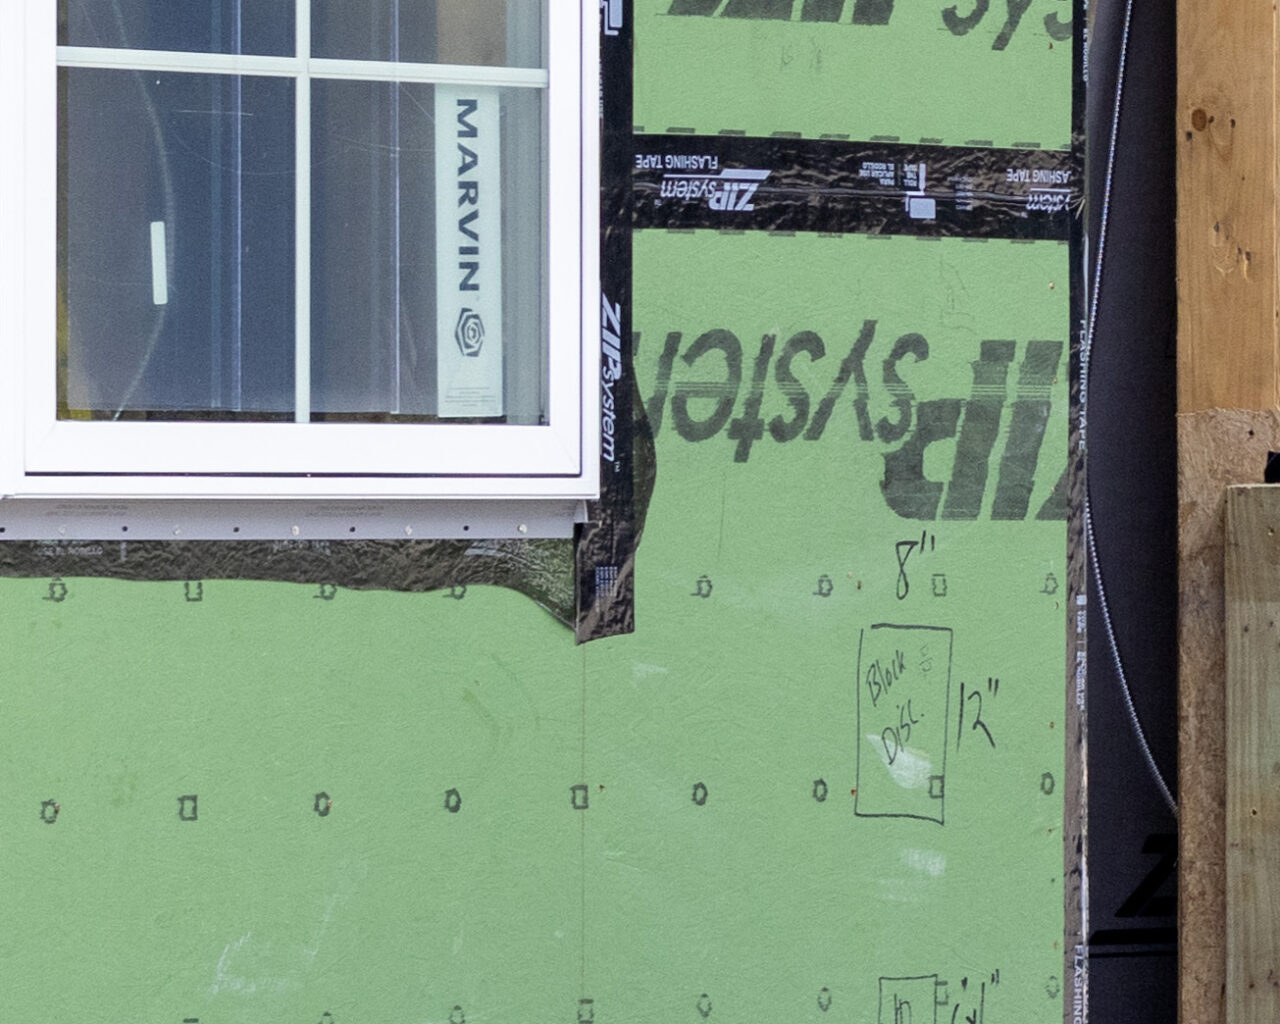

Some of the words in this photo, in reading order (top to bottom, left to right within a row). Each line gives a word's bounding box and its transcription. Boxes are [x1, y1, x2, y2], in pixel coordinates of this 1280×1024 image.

[635, 154, 662, 169] TAPE
[666, 154, 718, 170] FLASHING
[1006, 168, 1030, 183] TAPE
[456, 99, 480, 292] MARVIN
